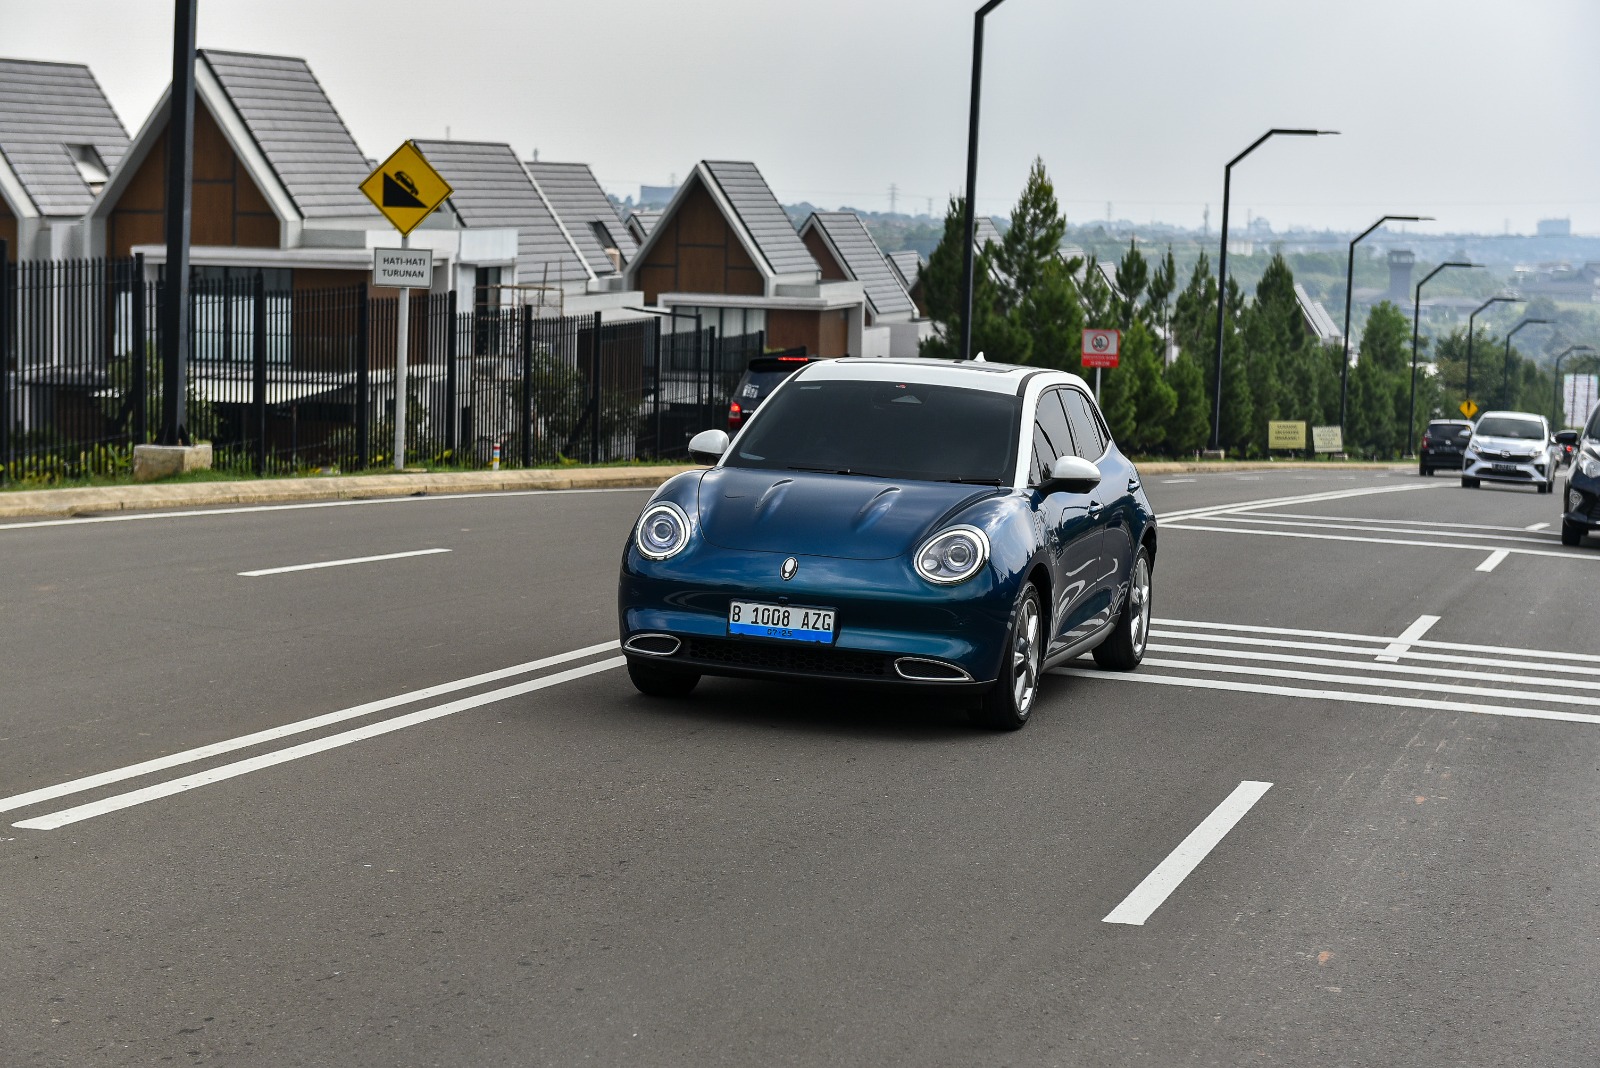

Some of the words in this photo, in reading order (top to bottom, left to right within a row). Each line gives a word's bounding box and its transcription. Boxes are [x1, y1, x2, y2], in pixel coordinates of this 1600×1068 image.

[383, 257, 426, 266] HATI-HATI
[382, 269, 425, 278] TURUNAN
[732, 605, 742, 622] B
[751, 607, 791, 627] 1008
[801, 611, 832, 631] AZG
